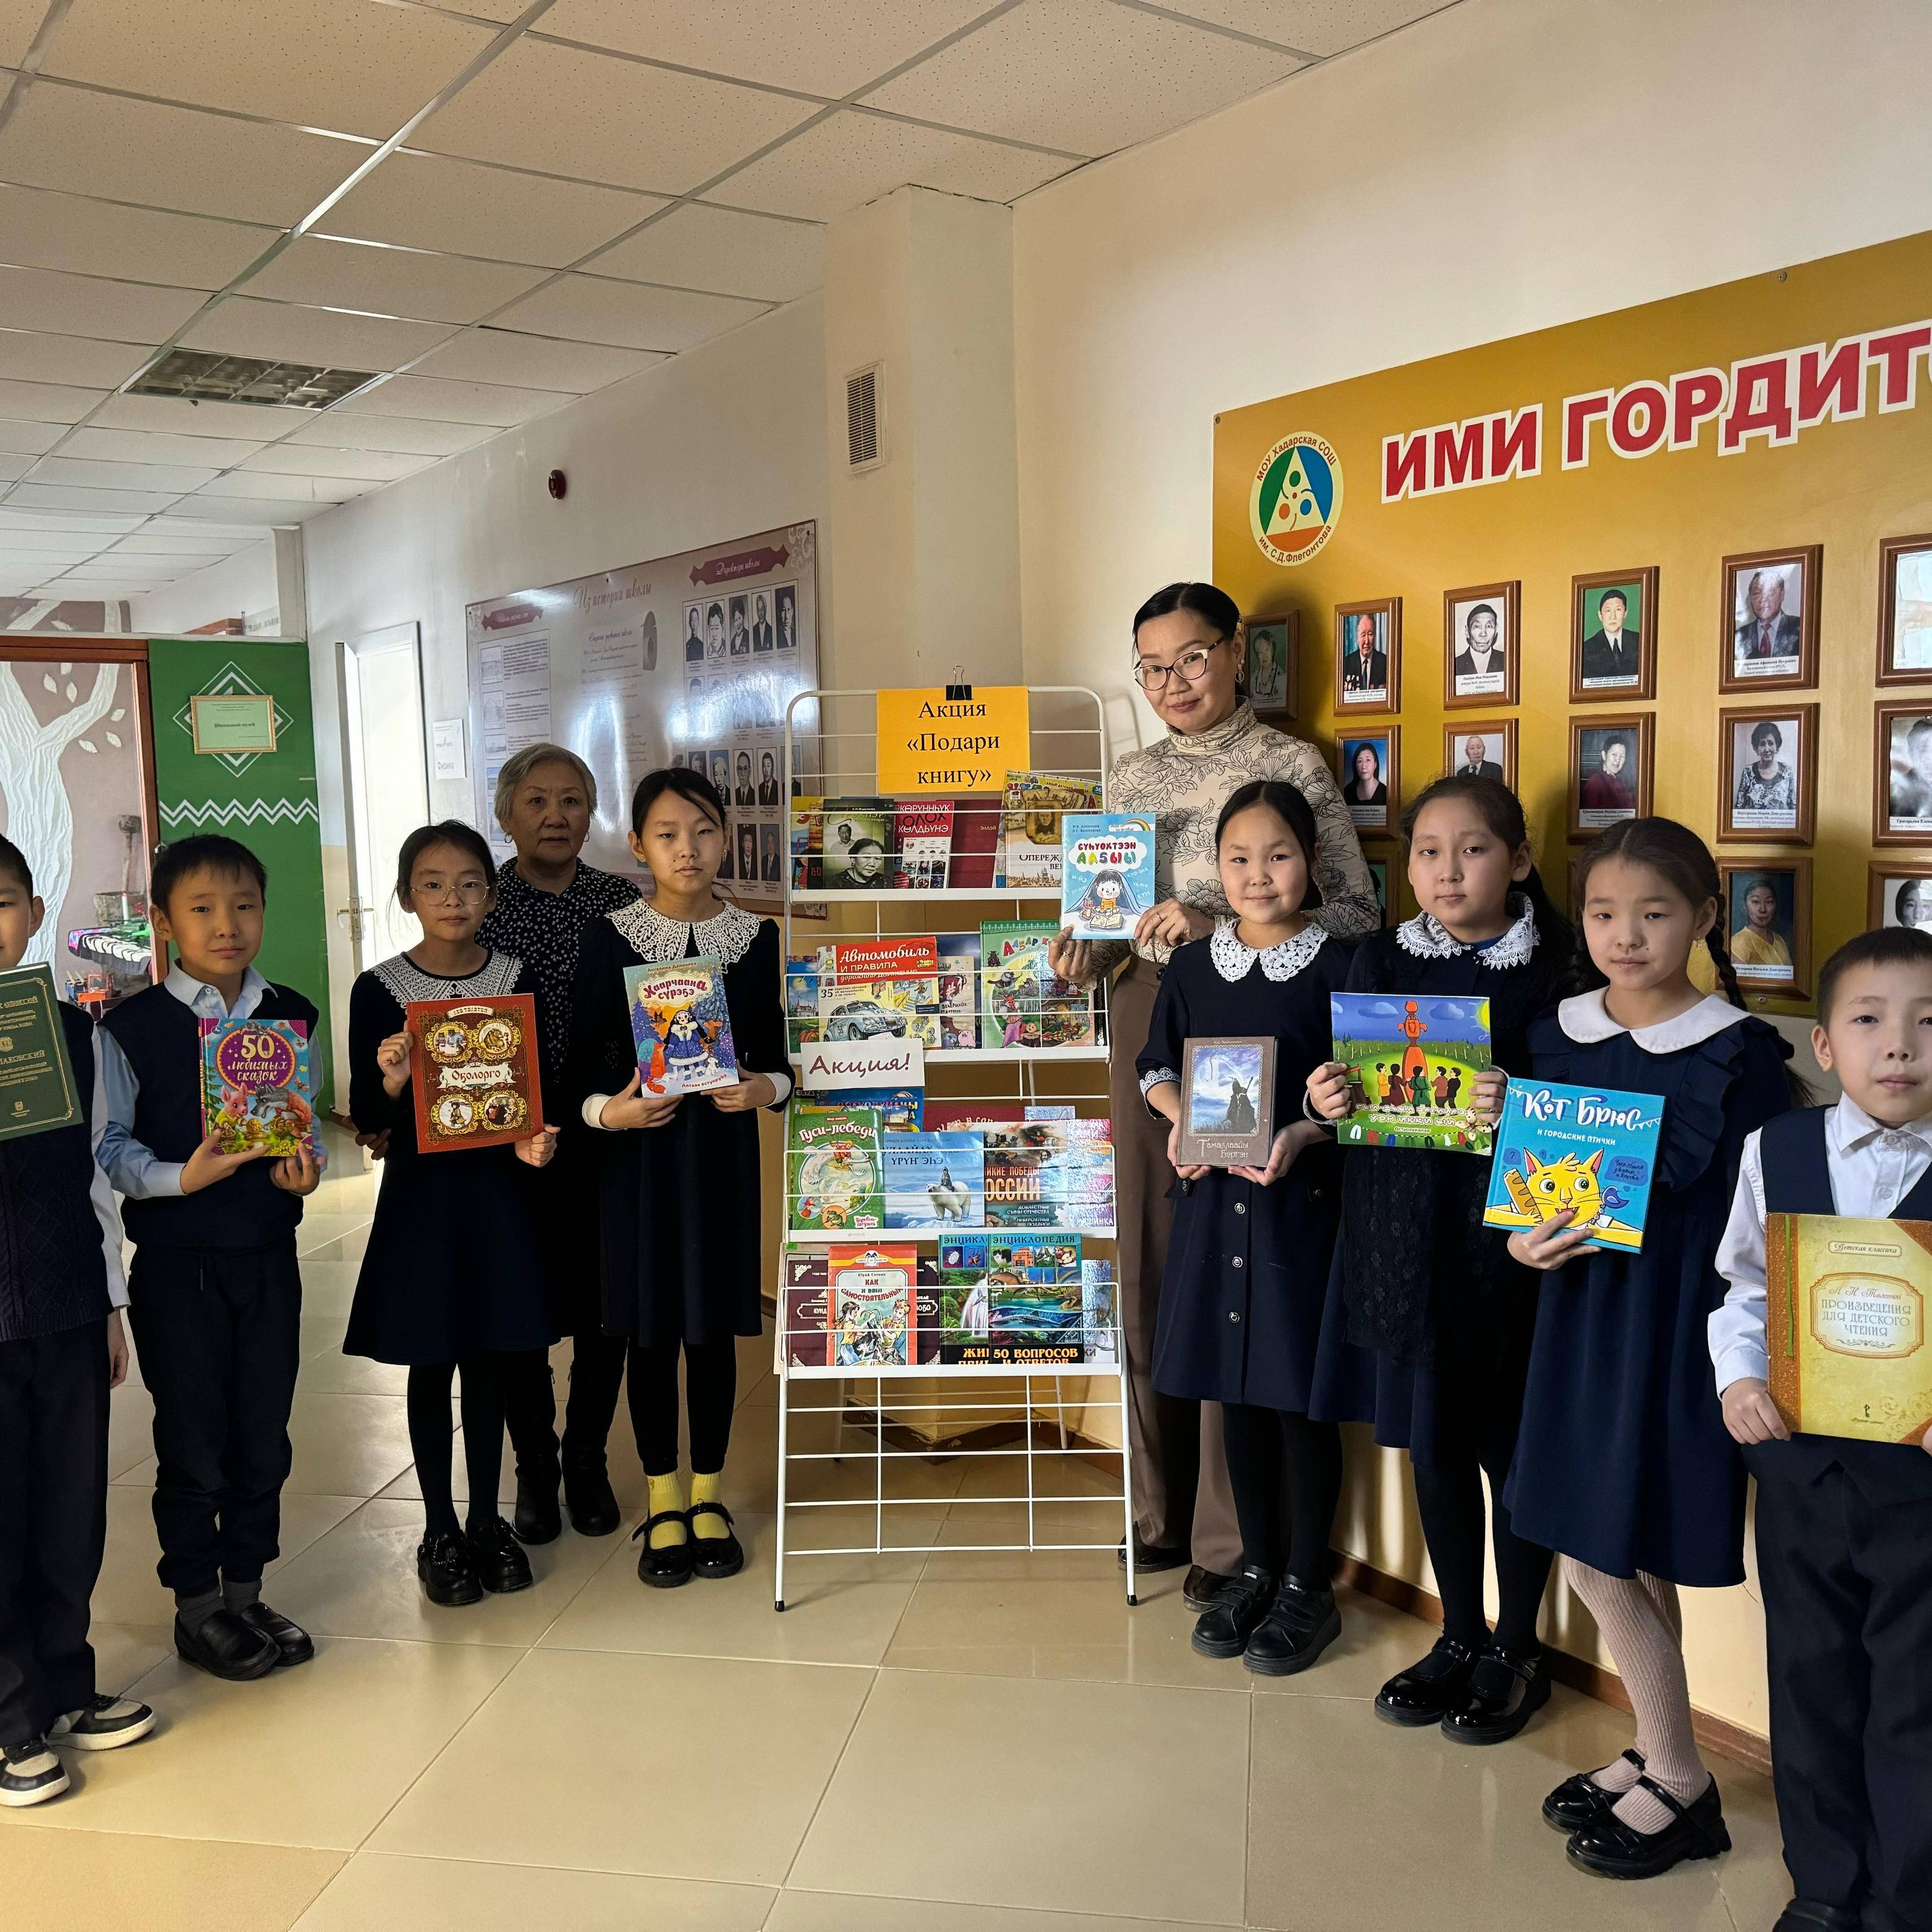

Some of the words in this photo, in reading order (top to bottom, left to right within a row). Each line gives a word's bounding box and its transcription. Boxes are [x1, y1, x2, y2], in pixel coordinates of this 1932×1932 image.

[1383, 407, 1539, 500] ИМИ
[1562, 320, 1932, 470] ГОРДИТ
[1256, 455, 1271, 482] МОУ
[1272, 436, 1317, 458] Хадарская
[1318, 442, 1337, 466] СОШ
[1259, 536, 1269, 553] им.
[918, 700, 986, 719] Акция
[907, 732, 1000, 754] «Подари
[917, 768, 991, 788] книгу»
[840, 944, 929, 964] Автомобиль
[672, 962, 697, 970] Данилова
[851, 962, 898, 972] ПРАВИЛА
[643, 978, 707, 998] Хаарчаана
[821, 989, 833, 998] 35
[240, 1035, 275, 1059] 50
[228, 1058, 288, 1071] любимых
[809, 1053, 910, 1077] Акция!
[237, 1071, 278, 1084] сказок
[1523, 1088, 1573, 1121] Кот
[1577, 1094, 1642, 1131] Брюс
[799, 1121, 877, 1143] Гуси-лебеди
[1544, 1129, 1586, 1142] ГОРОДСКИЕ
[1587, 1137, 1616, 1146] ПТИЧКИ
[986, 1167, 1006, 1176] ИКИЕ
[1009, 1166, 1040, 1178] ПОБЕДЫ
[986, 1178, 1040, 1201] ОССИИ
[993, 1236, 1075, 1245] ЭНЦИКЛОПЕДИЯ
[1834, 1243, 1866, 1252] Детская
[1822, 1299, 1912, 1315] ПРОИЗВЕДЕНИЯ
[1822, 1311, 1845, 1322] ДЛЯ
[1850, 1314, 1910, 1326] ДЕТСКОГО
[1844, 1325, 1887, 1336] ЧТЕНИЯ
[993, 1349, 1009, 1358] 50
[1014, 1348, 1078, 1358] ВОПРОСОВ
